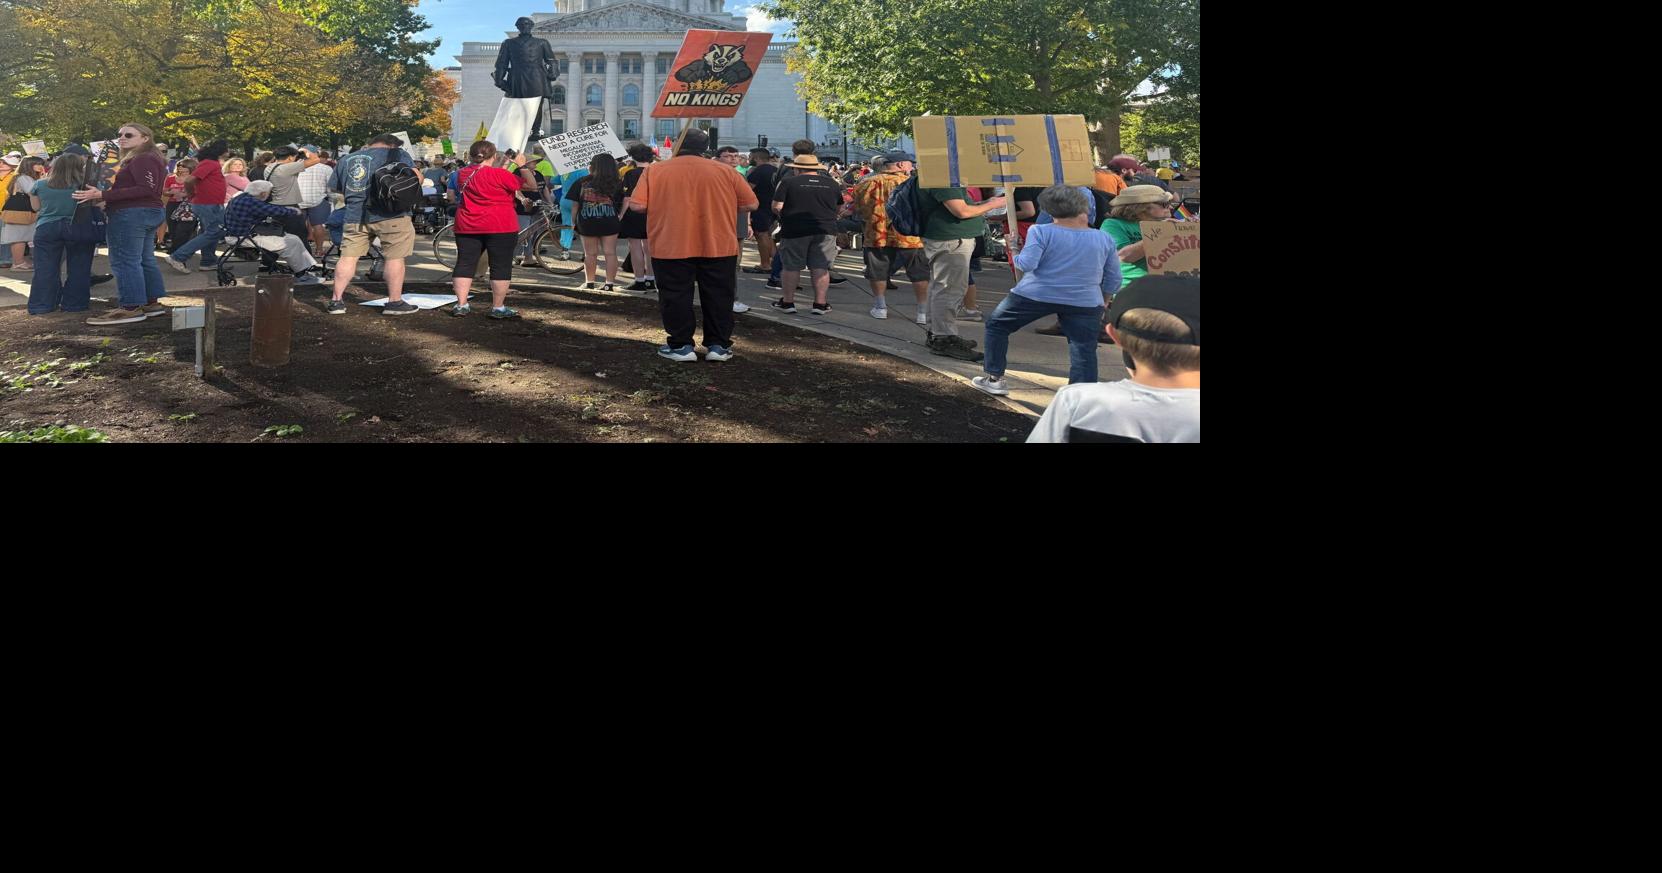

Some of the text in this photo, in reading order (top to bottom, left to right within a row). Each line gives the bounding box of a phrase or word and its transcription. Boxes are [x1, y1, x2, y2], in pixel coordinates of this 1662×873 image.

[664, 93, 741, 106] NO KINGS
[541, 122, 609, 146] FUND RESEARCH
[548, 141, 568, 151] NEED
[576, 133, 594, 143] CURE
[594, 130, 609, 138] FOR
[560, 139, 601, 153] MEGALOMANIA
[563, 143, 606, 158] INCOMPETENCE
[569, 148, 606, 160] CORRUPTION
[1144, 227, 1161, 241] We
[1148, 234, 1200, 269] Constit
